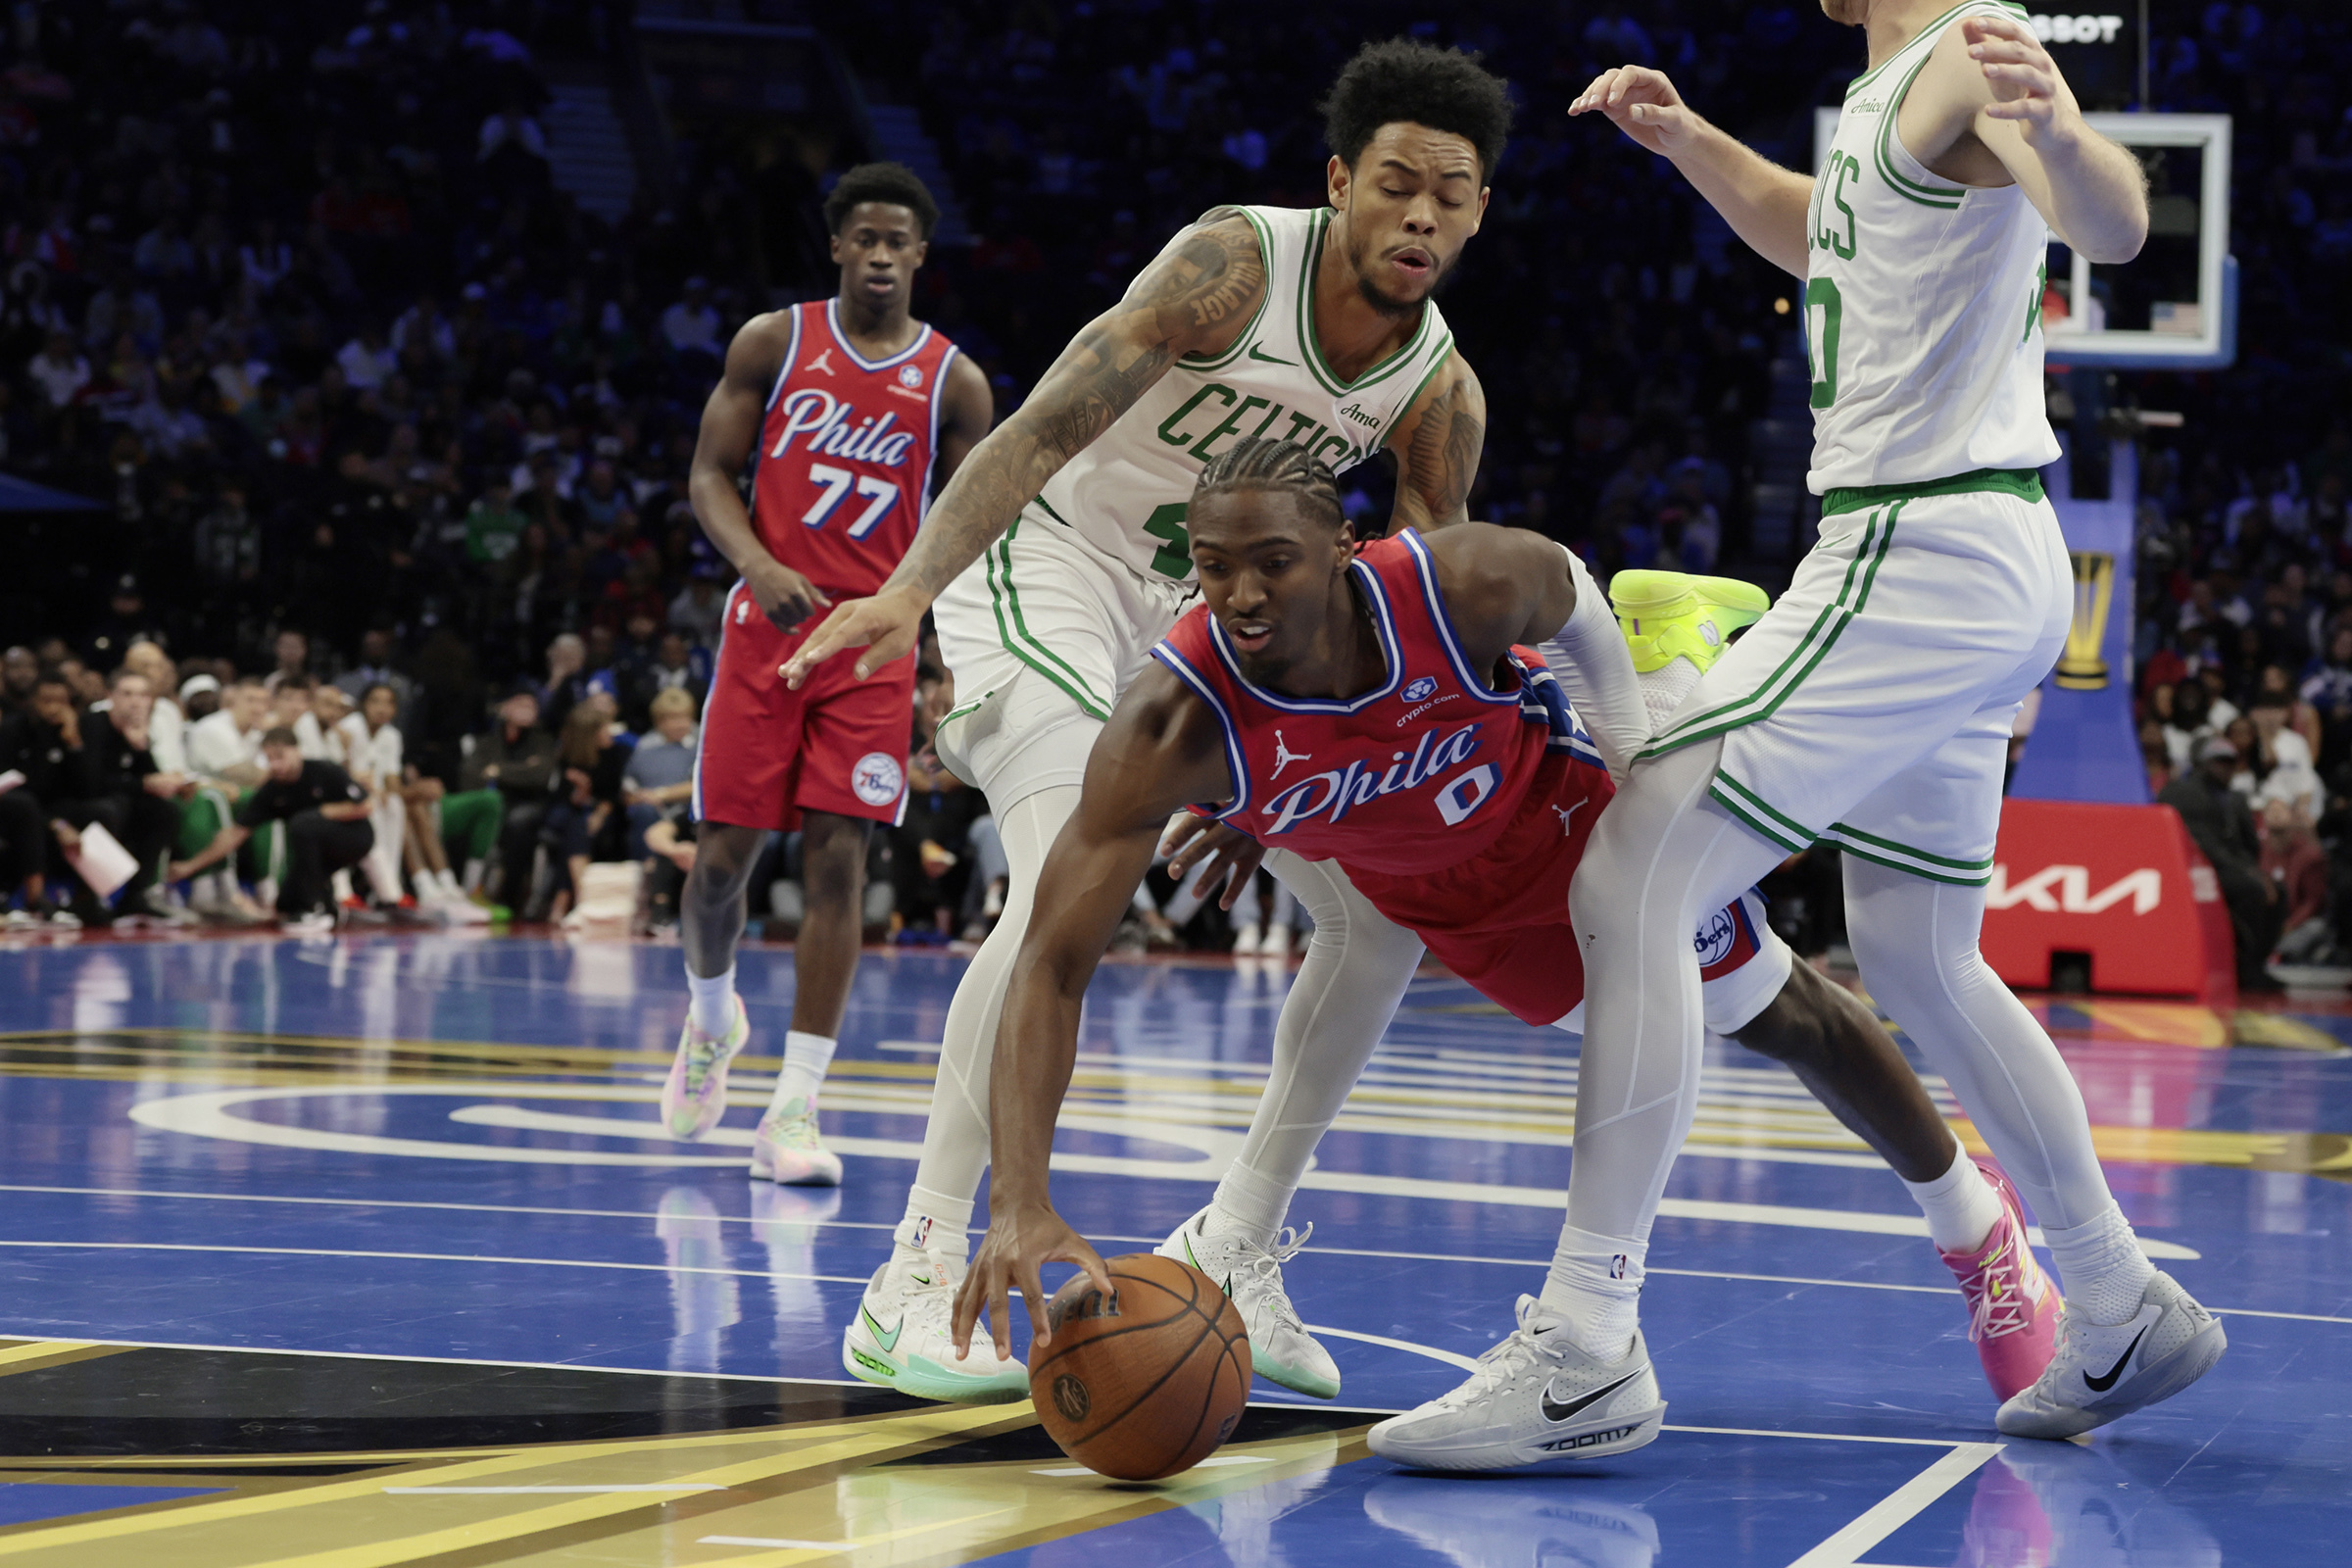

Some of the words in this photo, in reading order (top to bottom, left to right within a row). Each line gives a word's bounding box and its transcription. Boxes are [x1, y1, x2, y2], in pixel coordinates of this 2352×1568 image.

[770, 388, 916, 467] Phila
[801, 463, 900, 542] 77
[1396, 693, 1460, 728] crypto.com
[1261, 722, 1483, 835] Phila
[1434, 761, 1503, 826] 0
[1984, 861, 2162, 916] KIA
